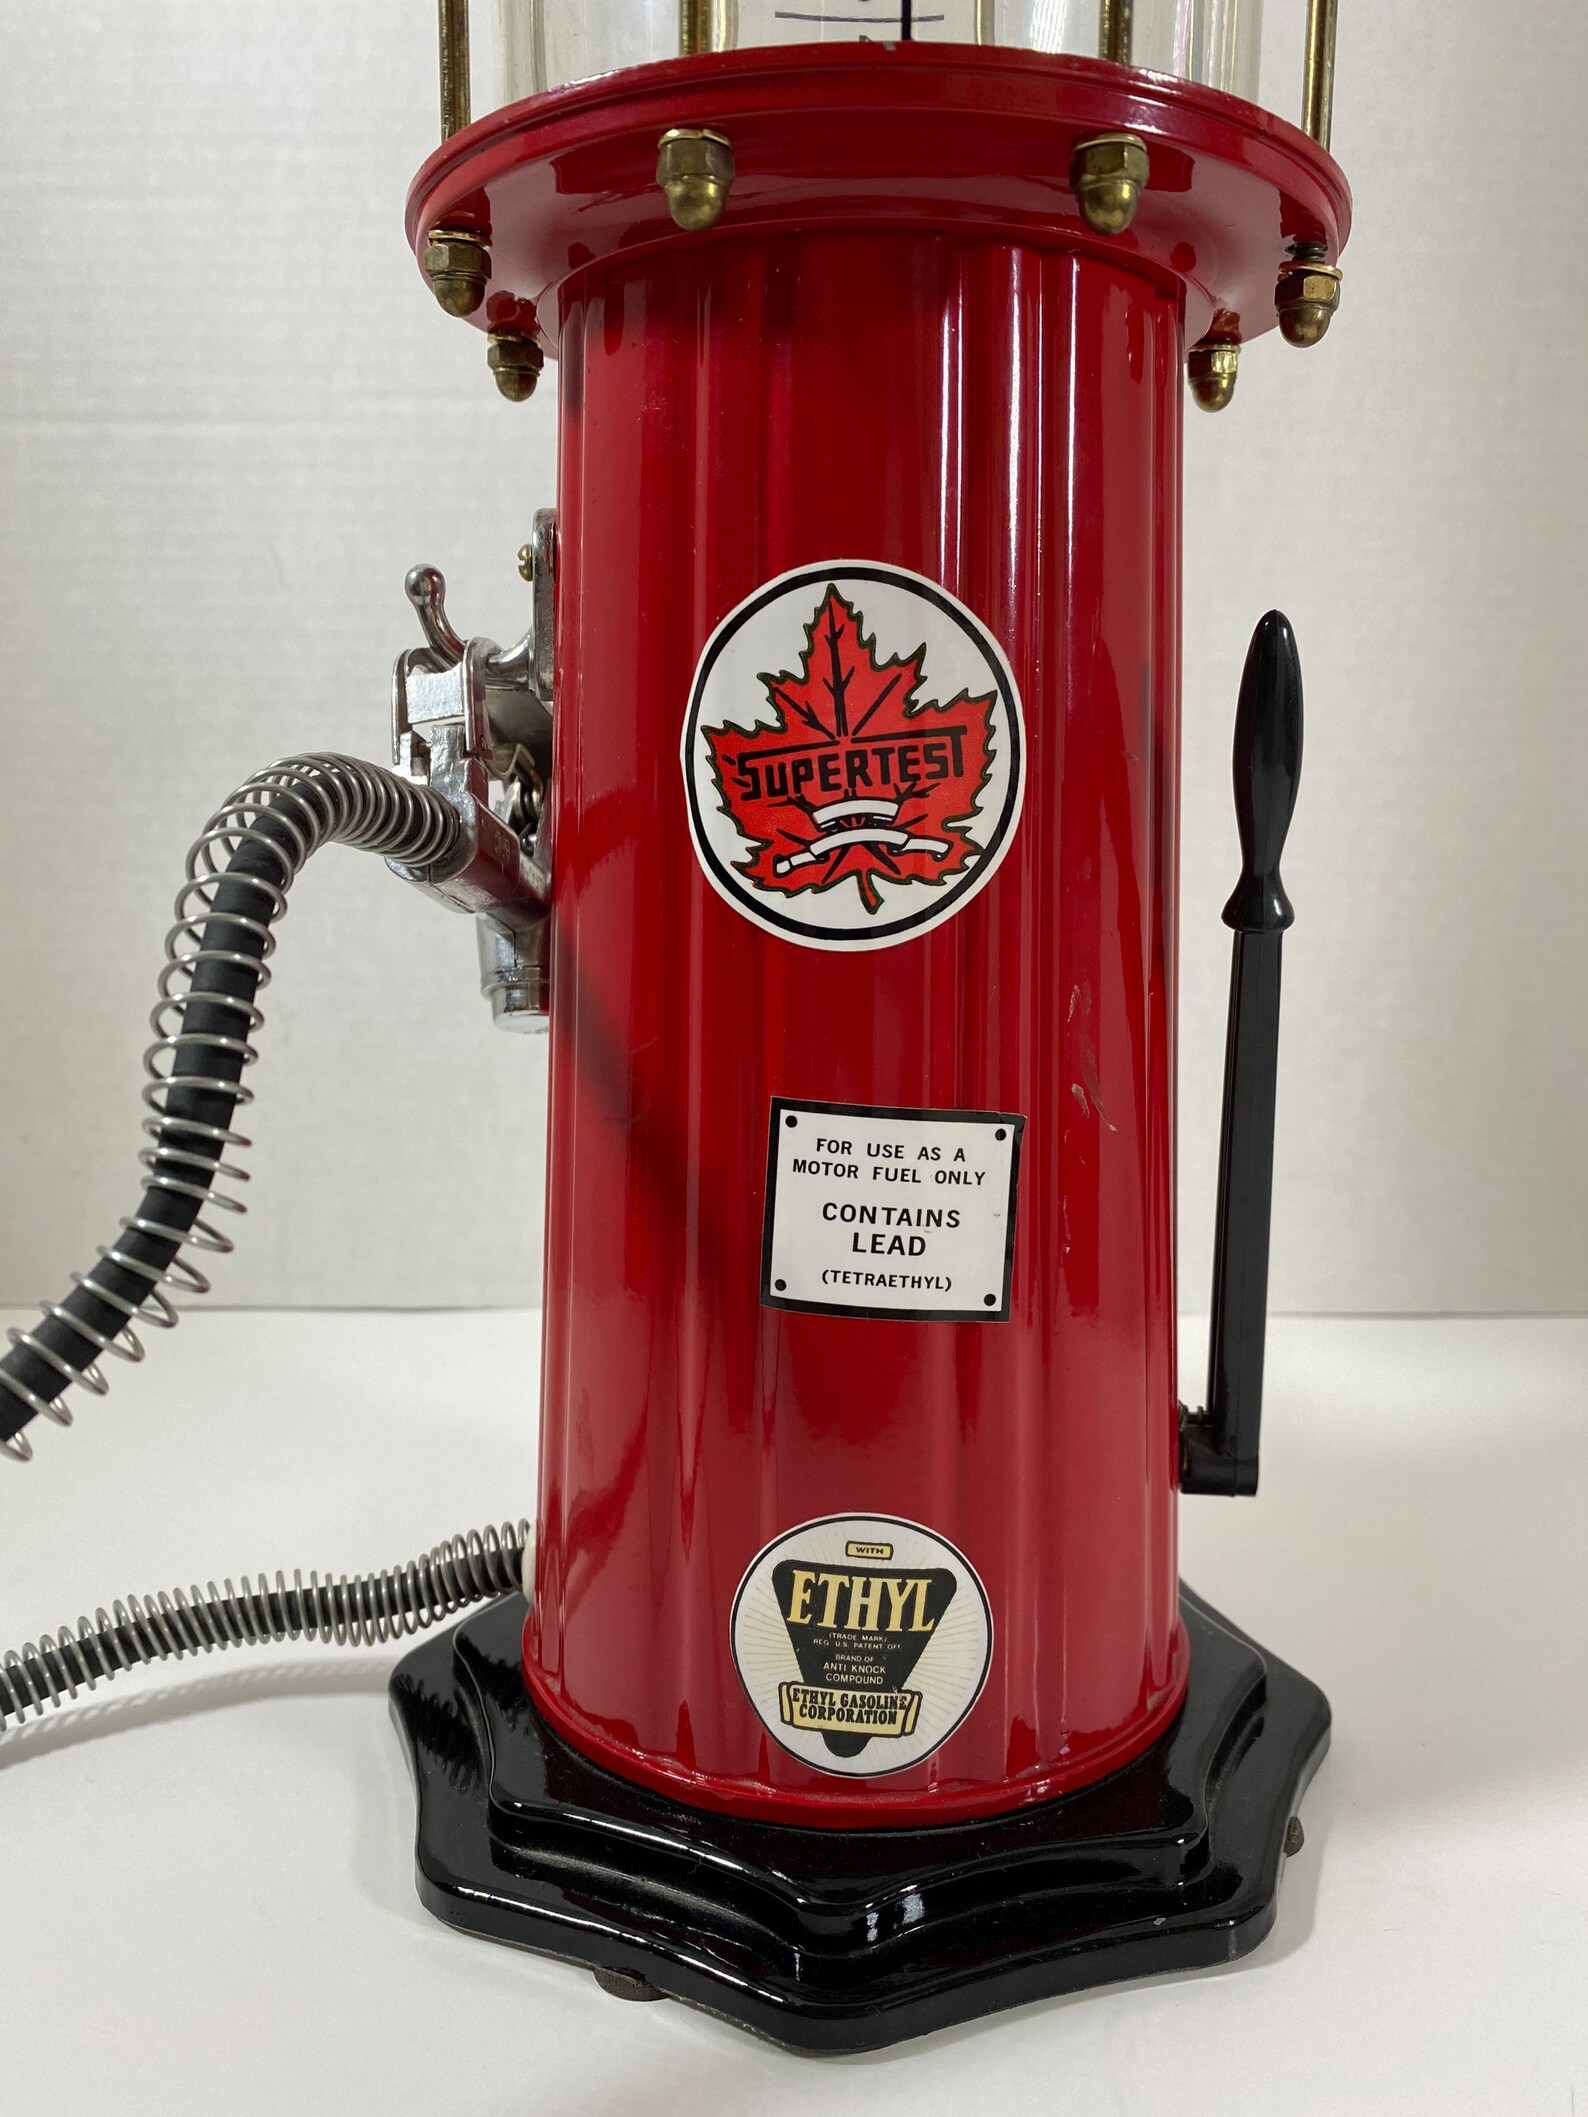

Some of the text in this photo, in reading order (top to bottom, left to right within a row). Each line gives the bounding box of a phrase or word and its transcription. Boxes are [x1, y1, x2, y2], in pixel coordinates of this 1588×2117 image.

[737, 725, 968, 801] SUPERTEST
[816, 1138, 966, 1162] FOR USE AS A
[792, 1159, 986, 1186] MOTOR FUEL ONLY
[822, 1202, 961, 1228] CONTAINS
[852, 1232, 926, 1257] LEAD
[821, 1269, 953, 1292] (TETRAETHYL)
[855, 1546, 884, 1555] WITH
[787, 1569, 935, 1632] ETHYL
[829, 1632, 857, 1641] (TRADE
[853, 1642, 883, 1650] PATENT
[823, 1662, 886, 1674] ANTI KNOCK
[835, 1653, 862, 1662] BRAND
[825, 1673, 884, 1685] COMPOUND
[792, 1687, 907, 1711] ETHYL GASOLINE
[799, 1704, 898, 1725] CORPORATION
